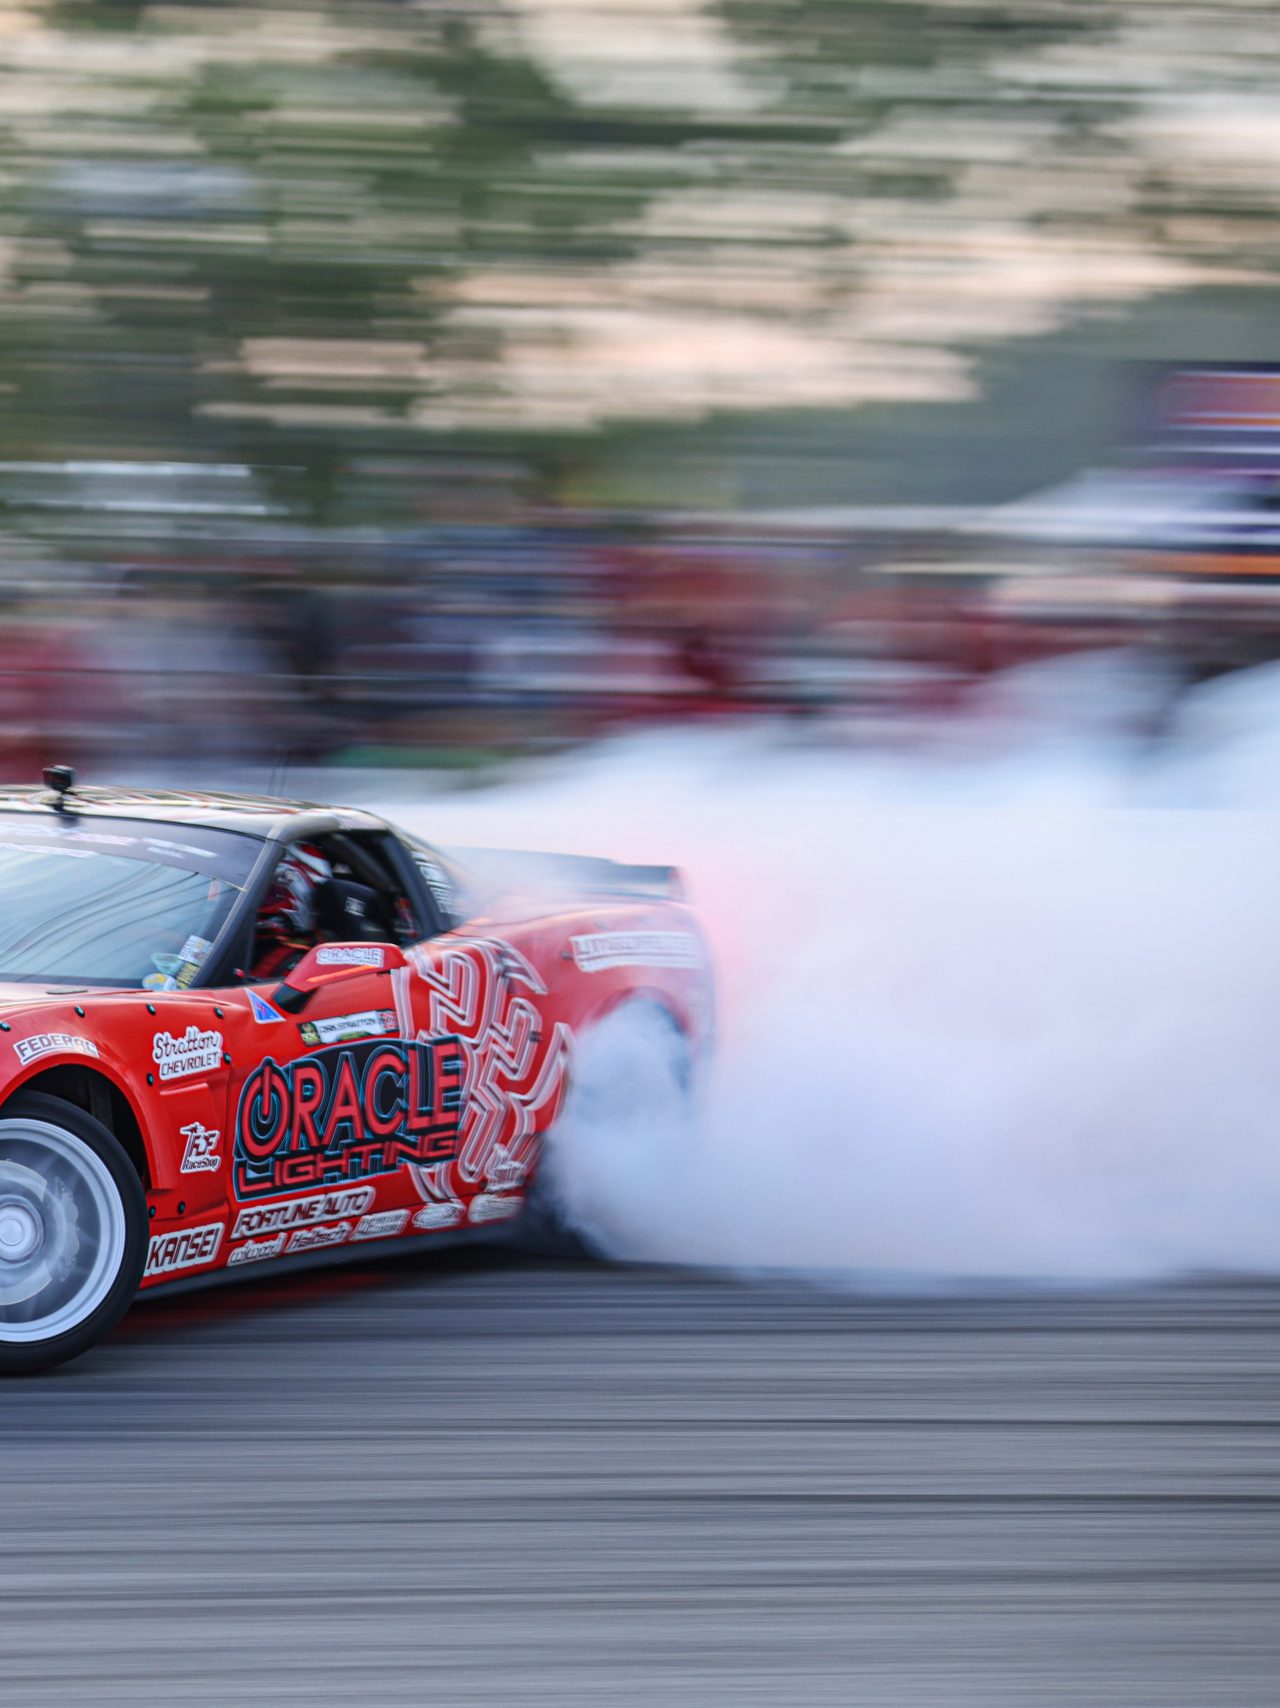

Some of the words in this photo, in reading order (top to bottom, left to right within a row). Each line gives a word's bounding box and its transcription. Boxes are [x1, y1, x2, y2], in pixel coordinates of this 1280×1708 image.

[15, 1034, 98, 1058] FEDERAL
[155, 1029, 219, 1059] Stratton
[161, 1051, 219, 1076] CHEVROLET
[241, 1042, 459, 1157] ORACLE
[238, 1130, 457, 1193] LIGHTING
[234, 1200, 318, 1236] FORTUNE
[319, 1191, 369, 1217] AUTO
[146, 1228, 220, 1270] KANSEI
